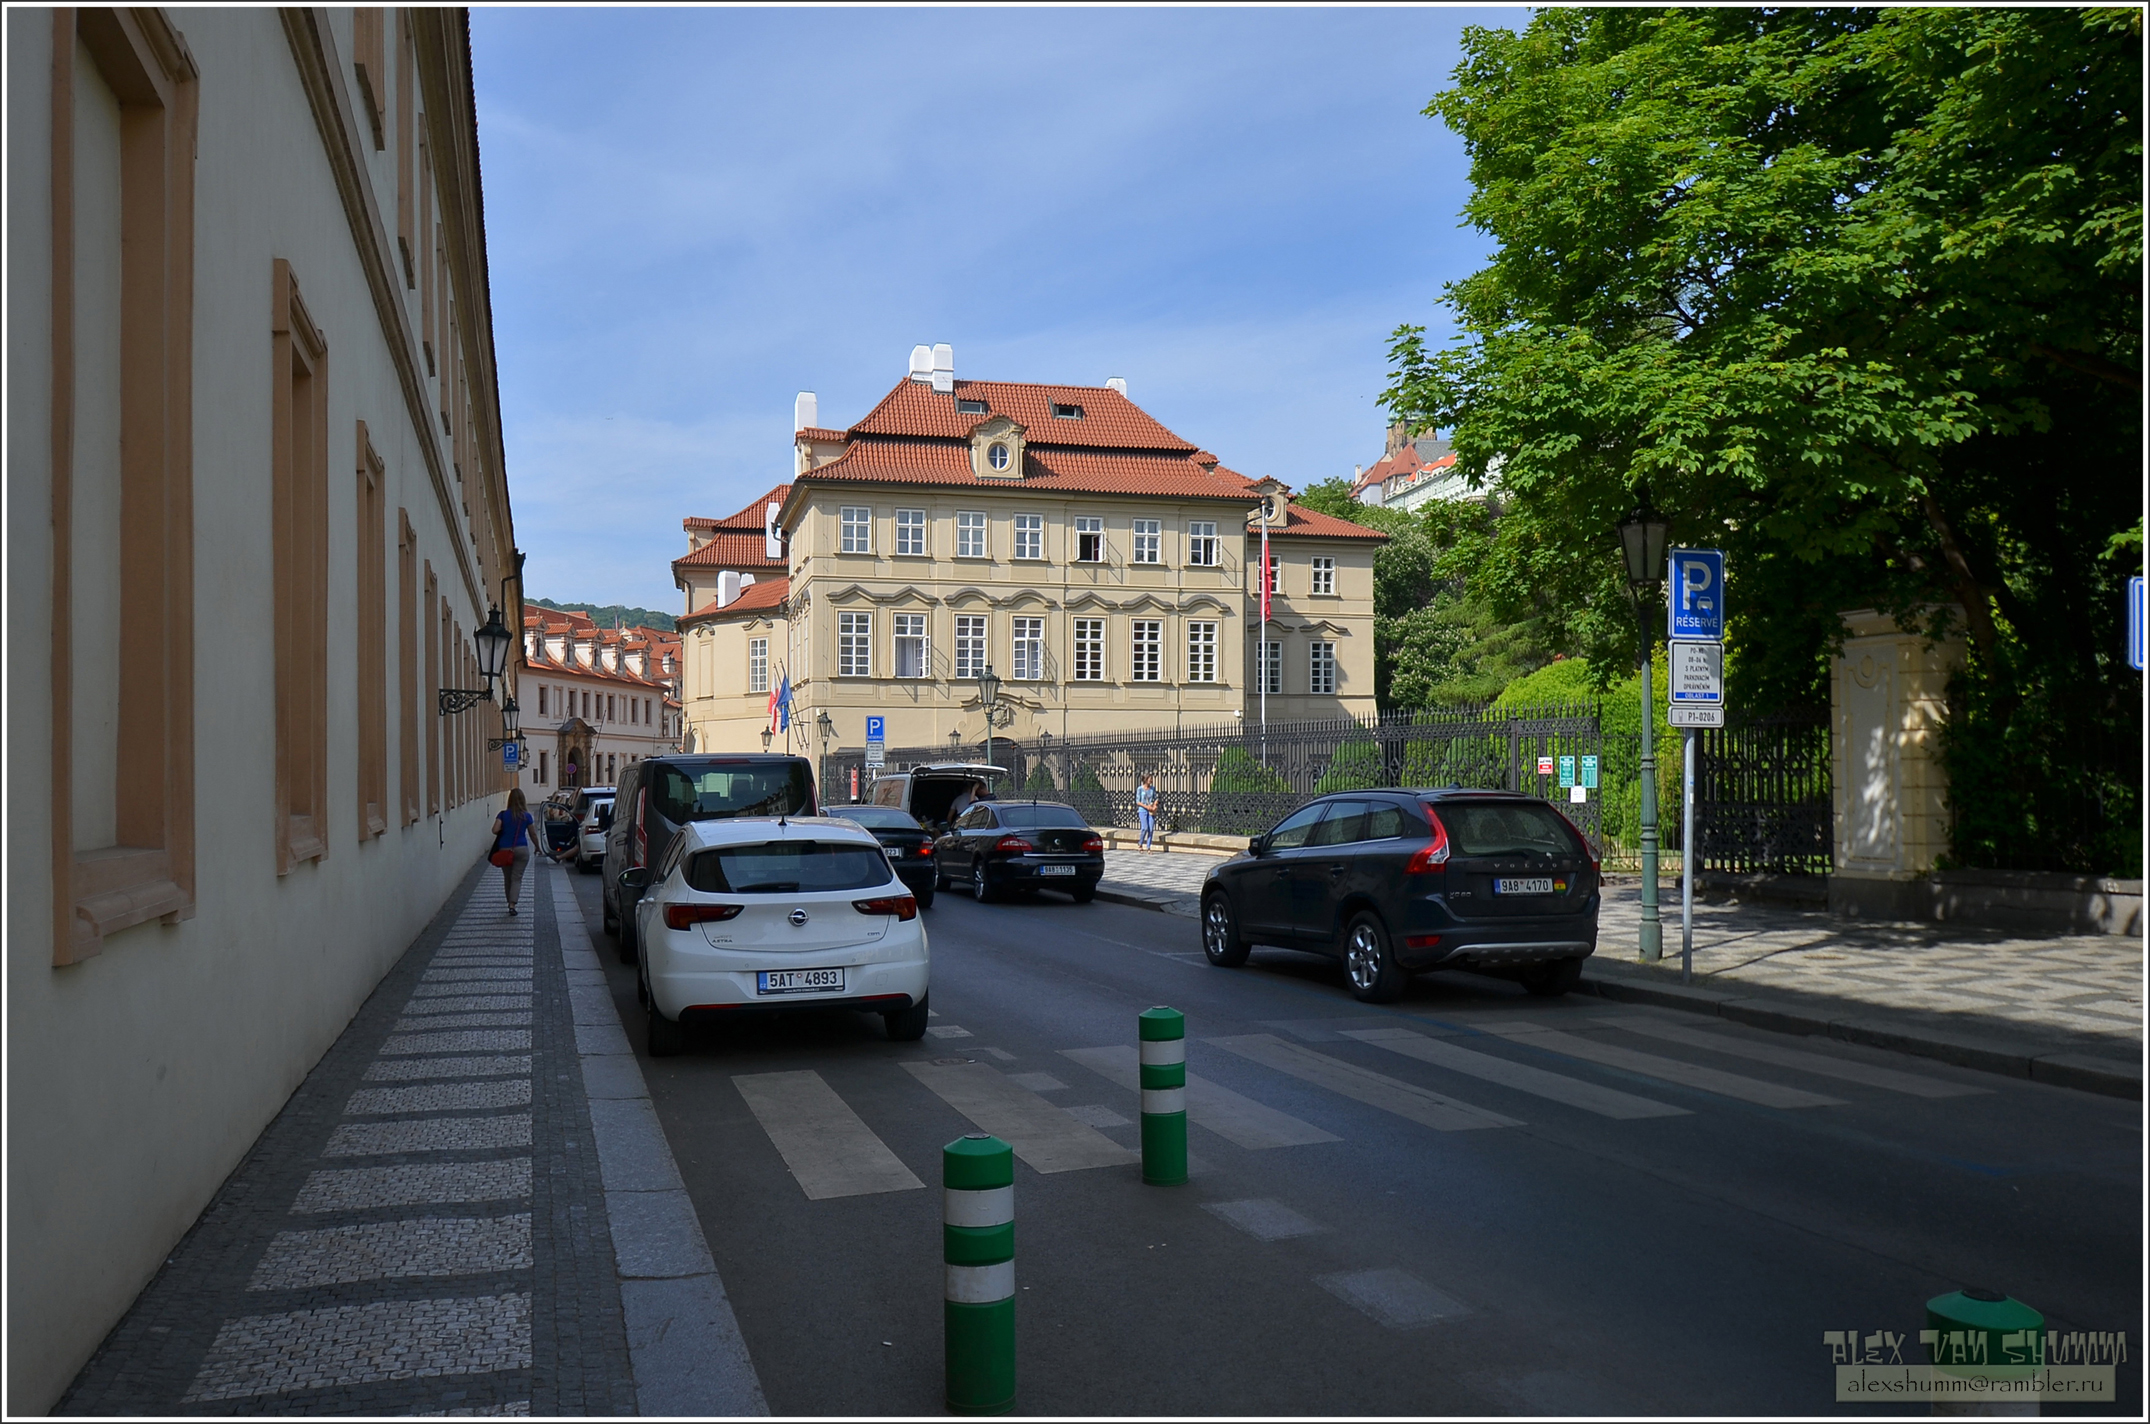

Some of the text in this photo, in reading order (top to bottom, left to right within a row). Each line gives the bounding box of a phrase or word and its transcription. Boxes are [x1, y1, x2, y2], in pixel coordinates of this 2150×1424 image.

[1683, 561, 1712, 610] P
[1676, 614, 1719, 628] RÉSERVÉ
[1688, 711, 1715, 722] P1-0206
[870, 719, 881, 735] P
[506, 745, 515, 758] P
[1502, 880, 1549, 893] 9A8 4170
[770, 971, 837, 987] 5AT 4893
